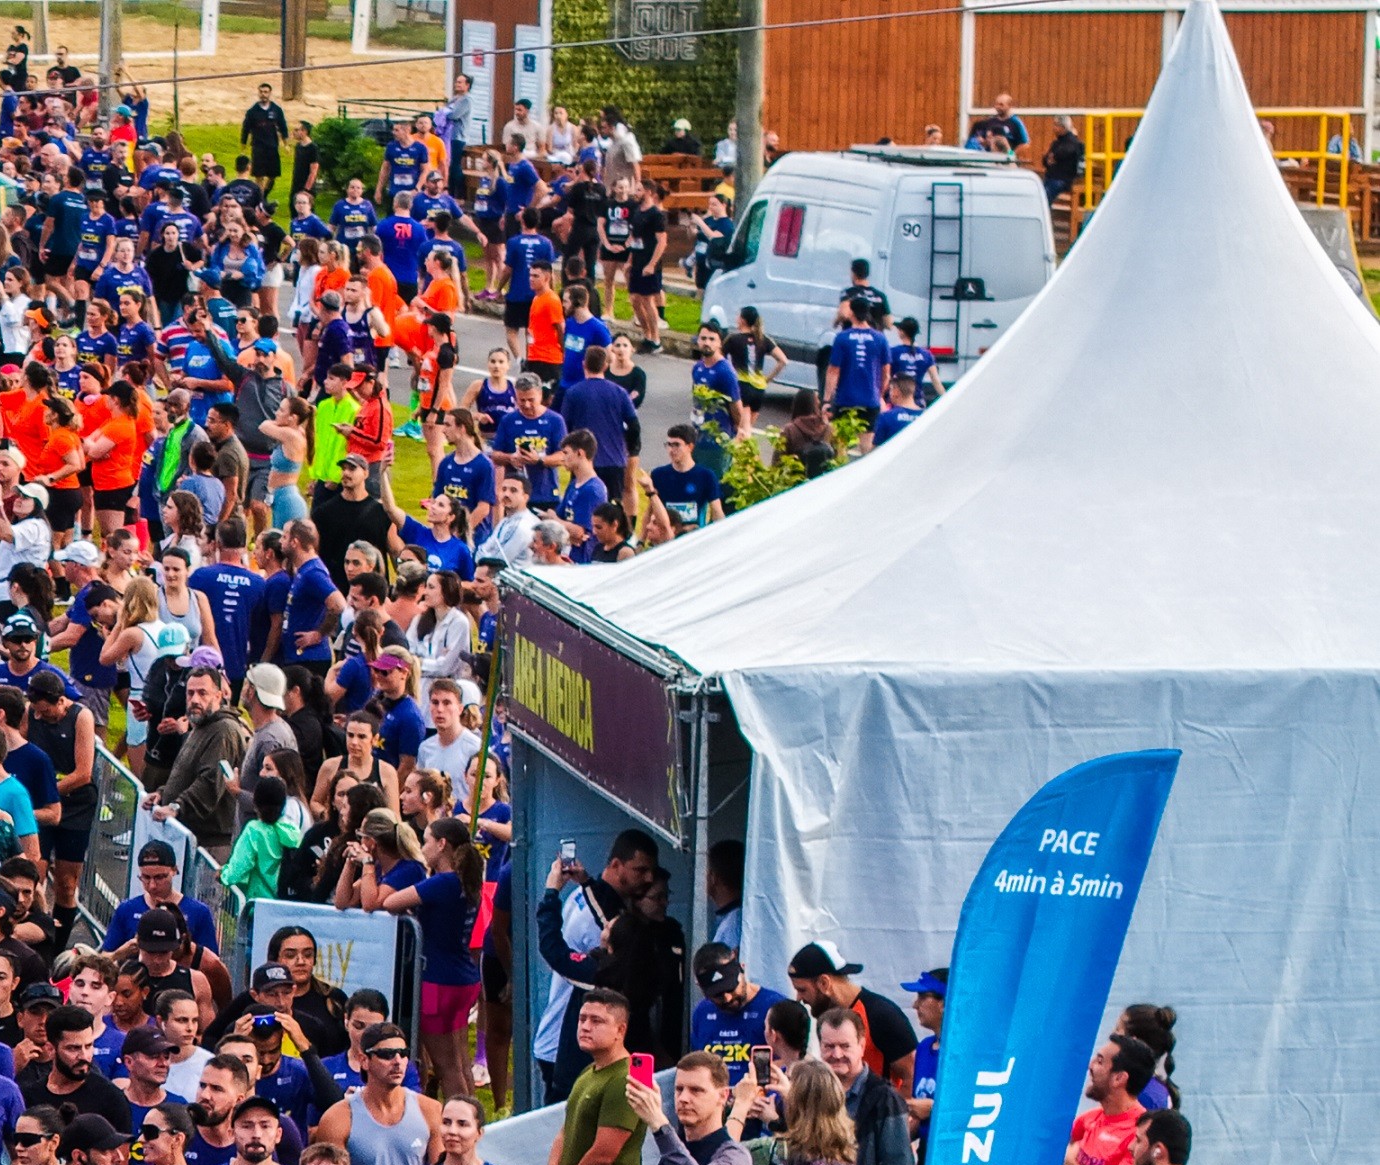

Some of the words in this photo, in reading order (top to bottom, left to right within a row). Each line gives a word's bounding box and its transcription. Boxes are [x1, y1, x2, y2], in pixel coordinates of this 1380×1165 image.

[902, 222, 921, 238] 90
[217, 573, 250, 586] ATLETA
[1039, 827, 1100, 856] PACE
[994, 868, 1047, 895] 4min
[1050, 871, 1065, 895] à
[1068, 875, 1123, 899] 5min
